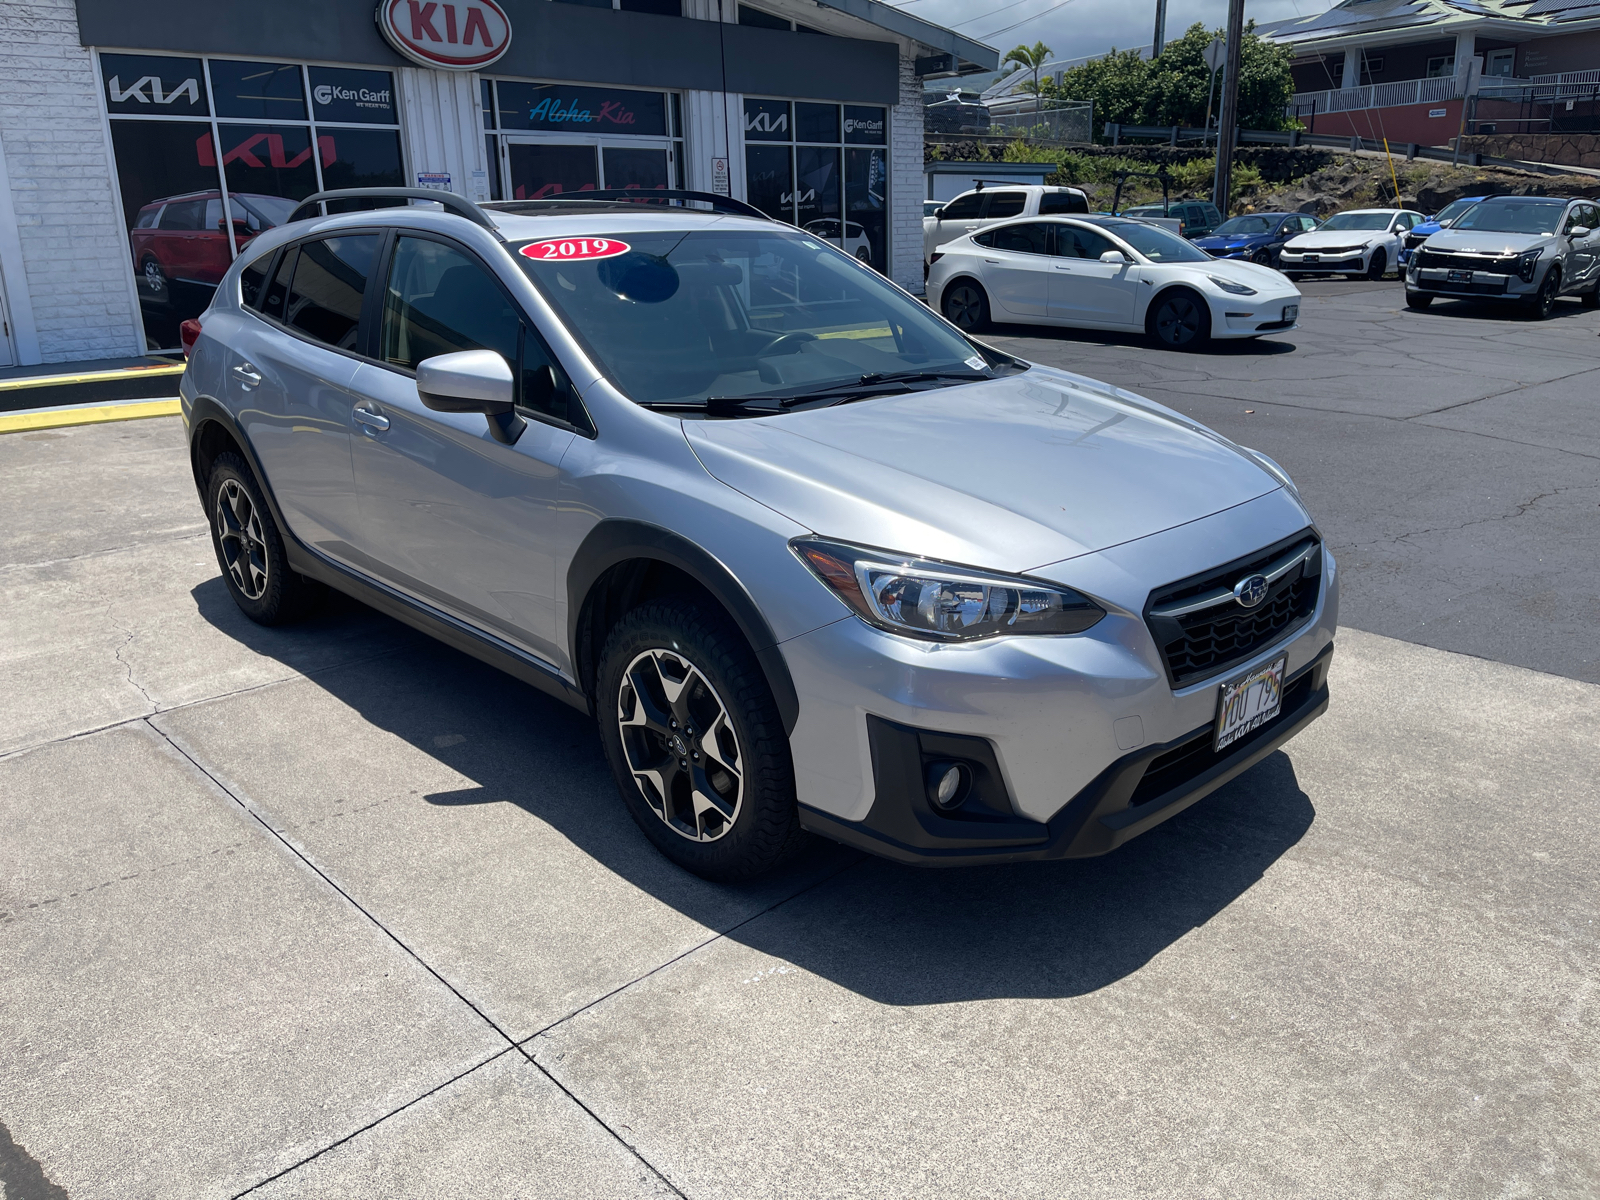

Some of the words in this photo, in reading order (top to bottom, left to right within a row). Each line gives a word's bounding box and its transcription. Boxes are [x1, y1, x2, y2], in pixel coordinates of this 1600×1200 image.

[407, 0, 494, 48] KIA
[108, 75, 200, 105] KIA
[332, 86, 358, 100] Ken
[359, 88, 390, 102] Garff
[529, 97, 593, 123] Aloha
[596, 100, 636, 124] Kia
[744, 111, 788, 133] KIA
[853, 119, 867, 129] Ken
[866, 120, 883, 130] Garff
[195, 132, 337, 169] KIA
[780, 188, 815, 204] KIA
[541, 239, 609, 258] 2019
[1222, 685, 1250, 732] YDU
[1256, 672, 1282, 711] 795
